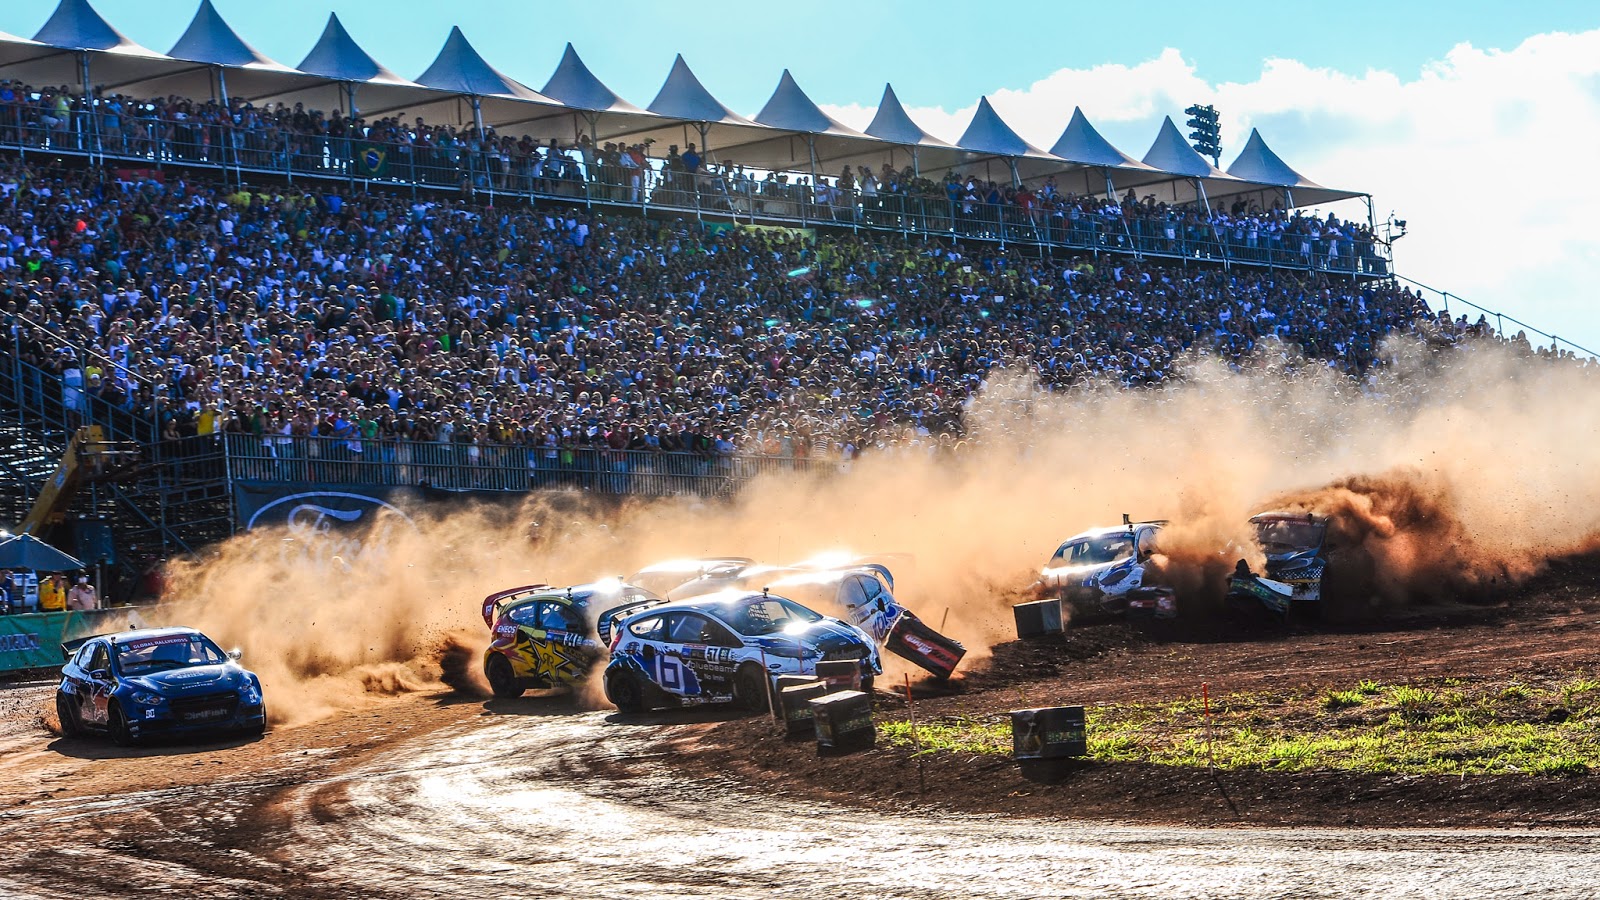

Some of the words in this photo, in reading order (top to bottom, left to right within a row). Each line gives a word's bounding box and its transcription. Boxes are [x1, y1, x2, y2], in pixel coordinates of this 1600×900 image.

[497, 625, 517, 634] ENEOS
[132, 641, 155, 649] GLOBAL
[155, 637, 189, 646] RALLYCROSS
[706, 647, 719, 662] 57
[690, 660, 733, 673] bluebeam
[145, 709, 155, 719] DC
[184, 708, 228, 720] DirtFish
